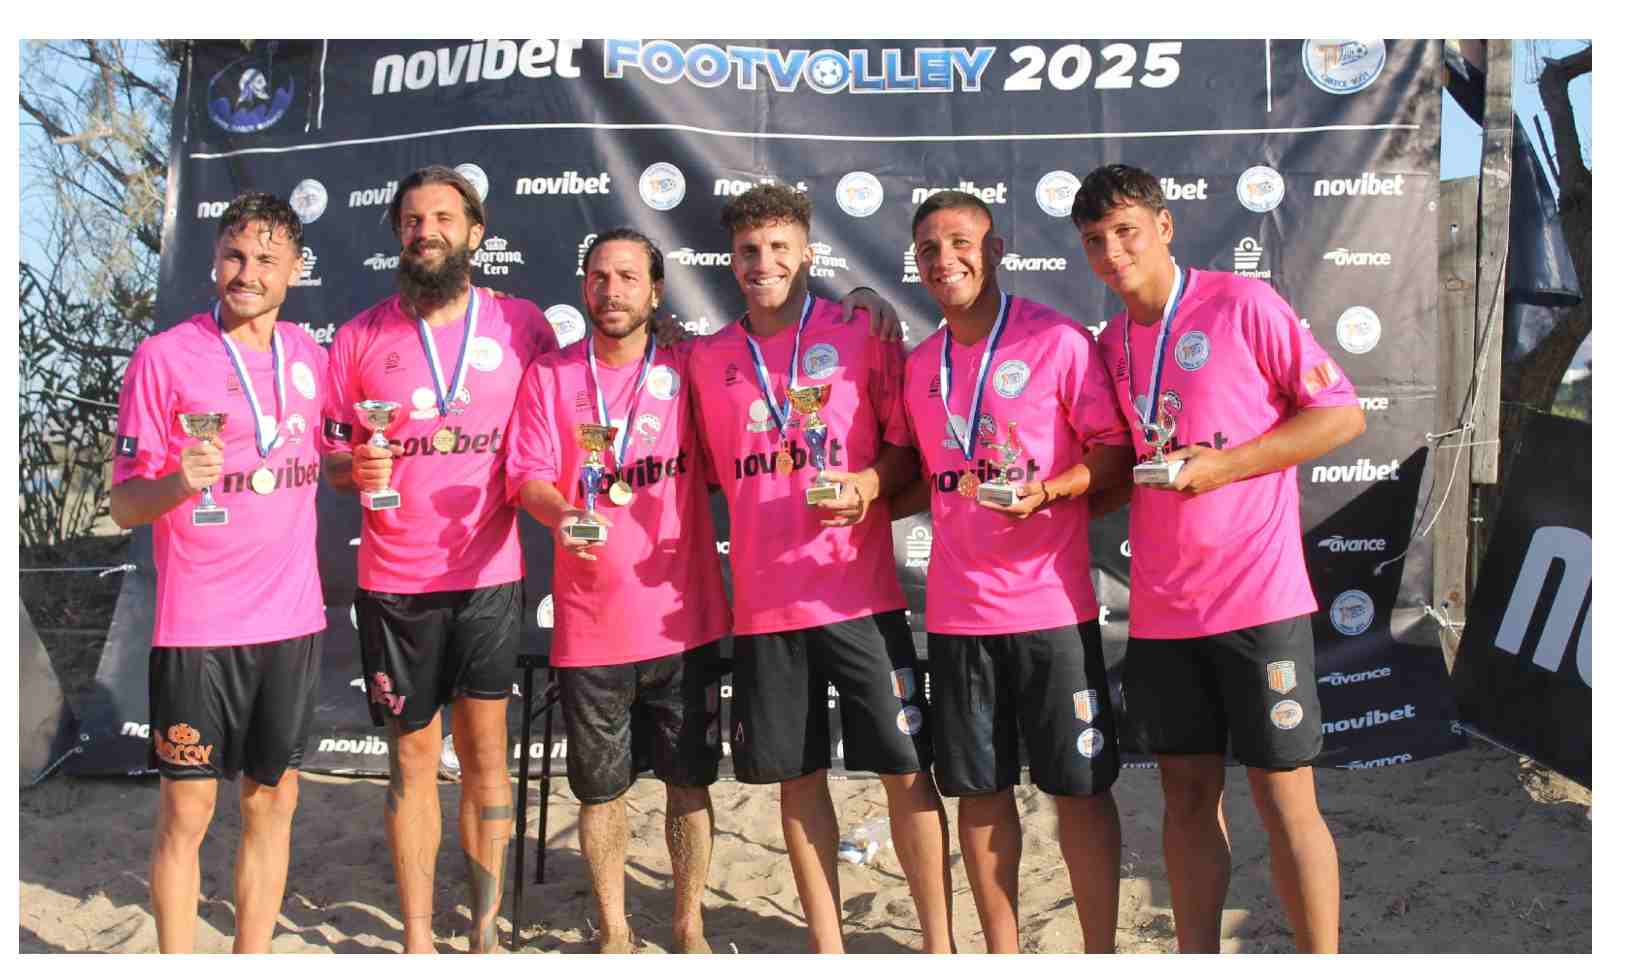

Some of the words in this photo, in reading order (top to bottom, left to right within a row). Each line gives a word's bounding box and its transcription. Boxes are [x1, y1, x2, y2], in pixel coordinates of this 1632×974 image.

[371, 39, 583, 96] novibet
[604, 39, 996, 95] FOOTVOLLEY
[1004, 42, 1182, 91] 2025
[516, 171, 611, 195] novibet
[1162, 177, 1208, 201] ibet
[1314, 173, 1405, 197] novibet
[1005, 255, 1067, 272] avance
[1334, 249, 1392, 266] avance
[483, 263, 509, 275] Cero
[1312, 459, 1400, 483] novibet
[1329, 537, 1386, 552] avance
[1328, 666, 1392, 686] avance
[1321, 704, 1416, 735] novibet
[318, 736, 389, 755] novib
